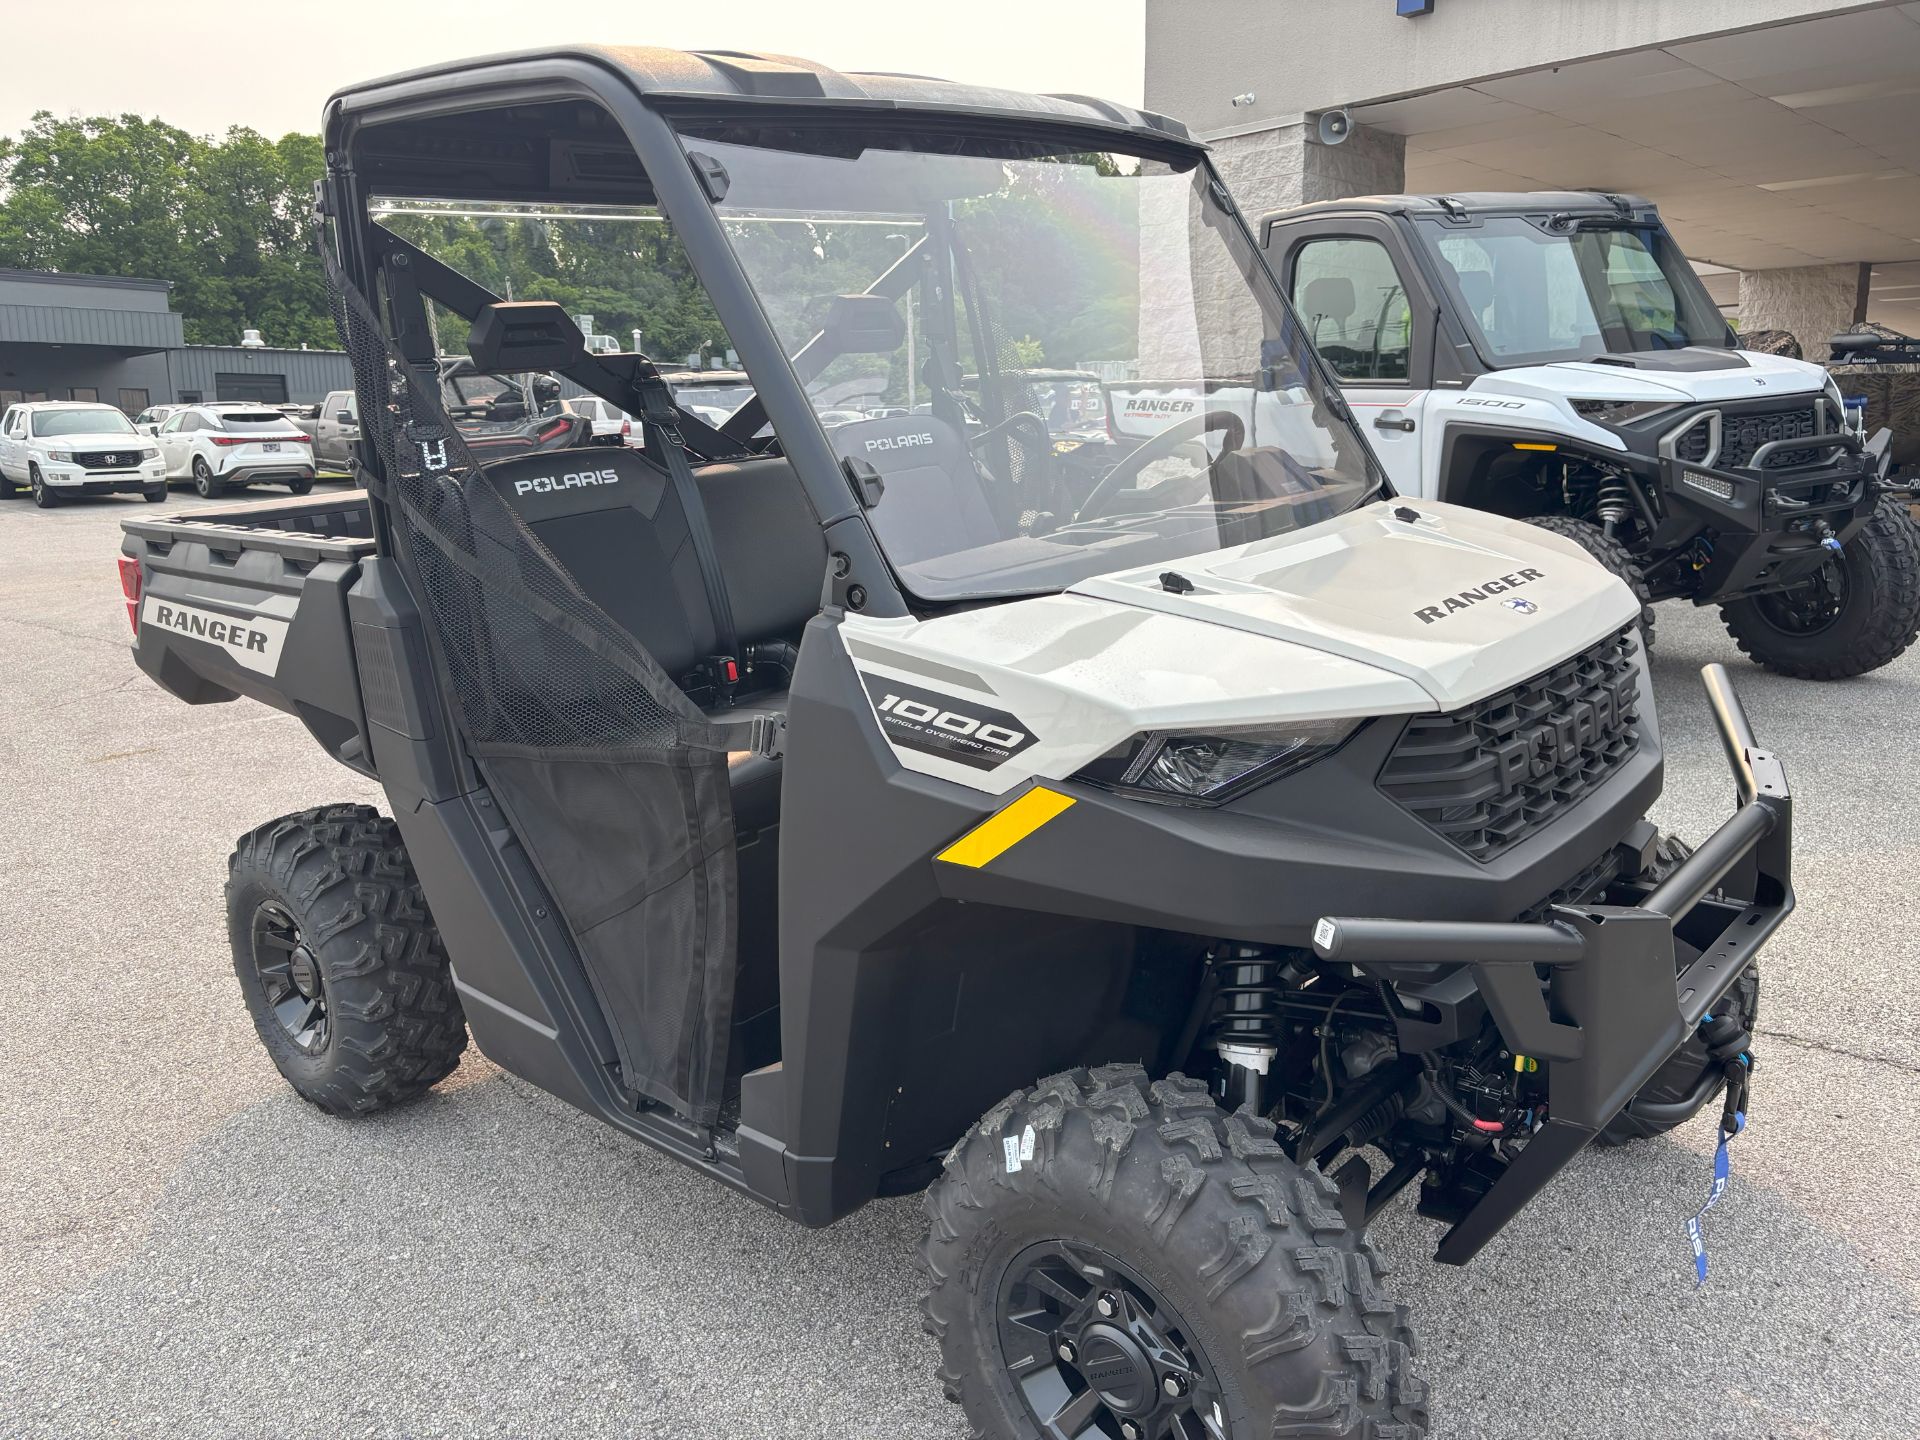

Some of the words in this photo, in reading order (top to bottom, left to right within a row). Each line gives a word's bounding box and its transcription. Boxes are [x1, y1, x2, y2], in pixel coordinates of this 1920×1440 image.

[1126, 399, 1194, 412] RANGER
[1456, 398, 1526, 410] 1500
[864, 432, 934, 453] POLARIS
[514, 469, 619, 496] POLARIS
[1412, 568, 1546, 625] RANGER
[156, 605, 268, 654] RANGER
[878, 694, 1025, 748] 1000
[884, 716, 923, 731] SINGLE
[925, 727, 982, 750] OVERHEAD
[983, 746, 1010, 757] CAM
[1498, 662, 1641, 797] POLARIS
